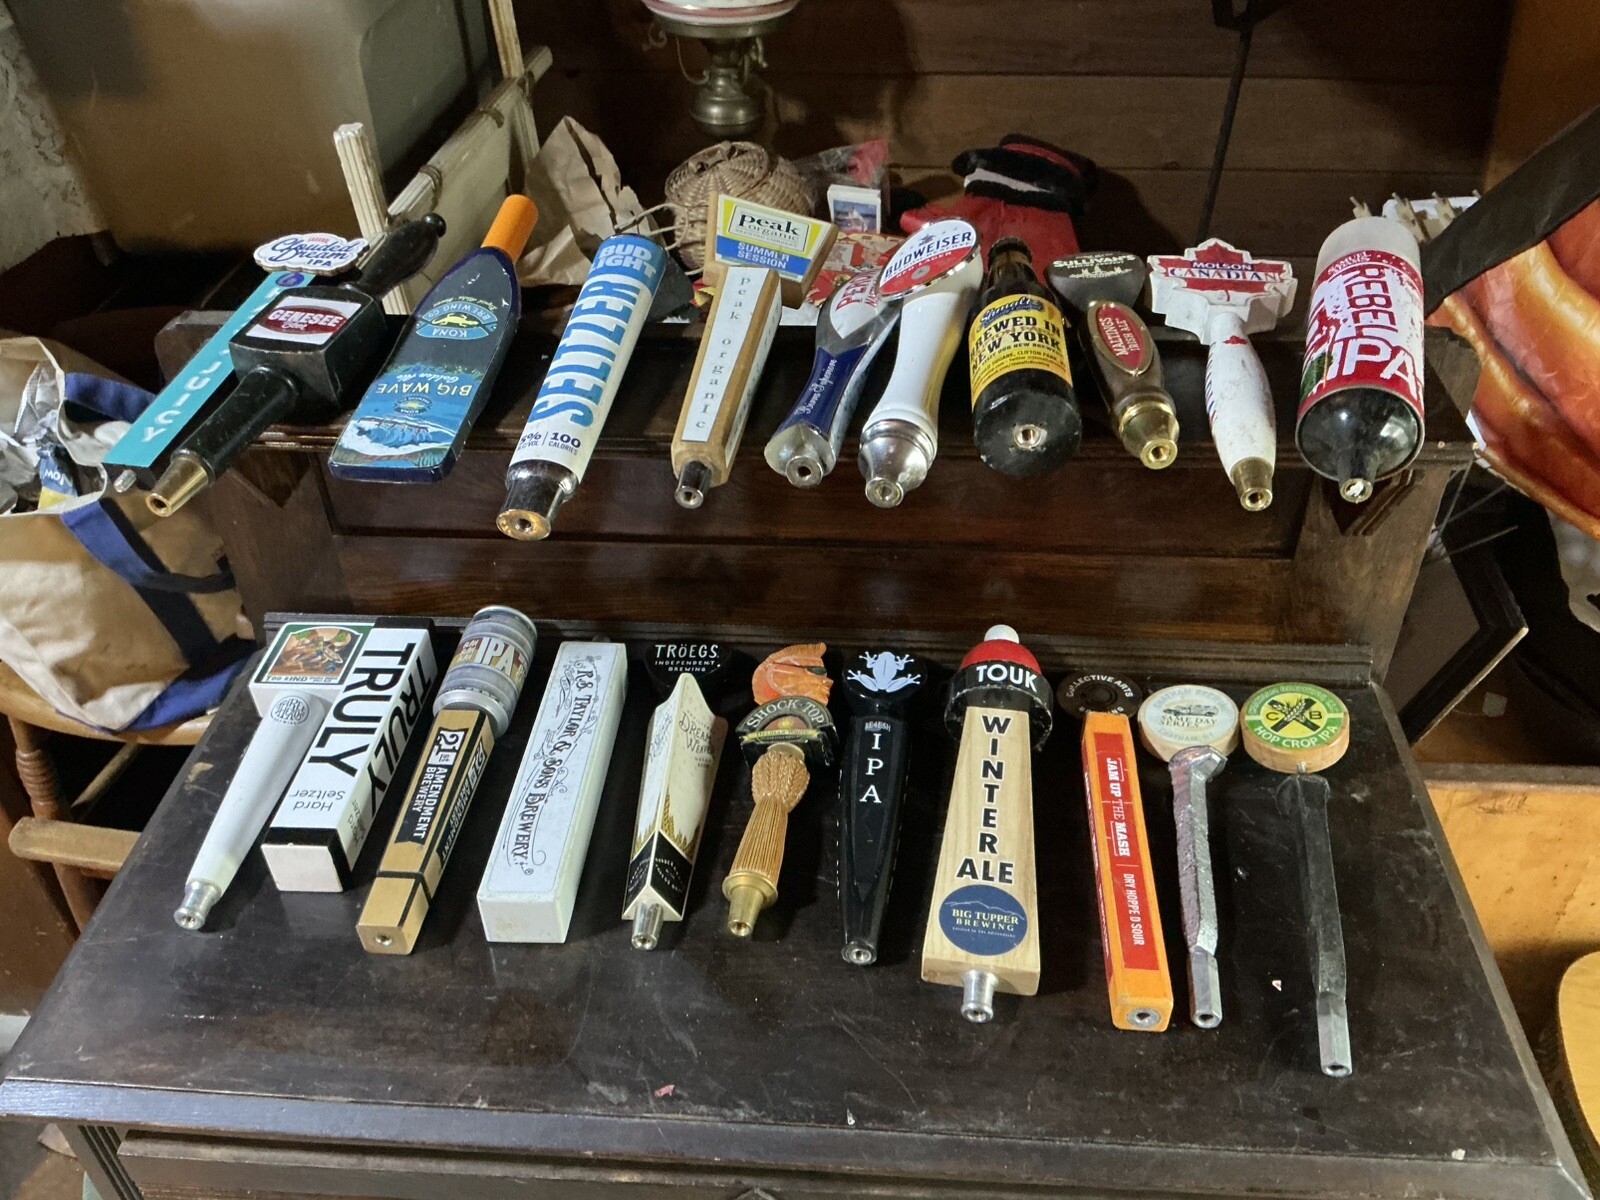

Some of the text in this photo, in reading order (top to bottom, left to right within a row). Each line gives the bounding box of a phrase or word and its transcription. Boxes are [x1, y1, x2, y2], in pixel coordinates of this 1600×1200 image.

[739, 214, 800, 236] peak
[748, 224, 799, 242] organic
[268, 248, 349, 262] Dream
[272, 238, 360, 252] Clouded
[599, 243, 652, 261] BUD
[738, 242, 790, 262] SUMMER
[885, 231, 972, 278] BUDWEISER
[307, 259, 332, 267] IPA
[590, 256, 657, 278] LIGHT
[737, 250, 787, 269] SESSION
[1053, 255, 1136, 268] SULLIVAN'S
[1193, 261, 1252, 271] MOLSON
[1170, 268, 1280, 282] CANADIAN
[443, 303, 491, 321] BREWING
[1343, 267, 1398, 337] REBEL
[268, 309, 344, 327] GENESEE
[432, 328, 468, 338] KONA
[1044, 320, 1061, 337] IN
[528, 279, 642, 428] SELTZER
[696, 277, 751, 429] peak organic
[972, 337, 1002, 374] NEW
[1010, 331, 1060, 351] YORK
[418, 373, 459, 383] Golden
[1327, 338, 1418, 401] IPA
[375, 381, 473, 396] BIG WAVE
[142, 360, 222, 442] JUICY
[549, 440, 578, 456] CALORIES
[551, 432, 581, 448] 100
[474, 636, 515, 677] IPA
[655, 643, 719, 659] TRÖEGS
[976, 664, 1038, 692] TOUK
[1066, 674, 1134, 698] COLLECTIVE ARTS
[308, 643, 417, 778] TRULY
[558, 695, 592, 740] TAYLOR
[747, 699, 825, 728] SHOCK TOP
[1265, 710, 1323, 721] C B
[1160, 720, 1200, 728] SERIES
[1195, 717, 1217, 725] DAY
[368, 656, 432, 818] TRULY
[1254, 726, 1338, 748] HOP CROP IPA
[549, 740, 572, 755] &
[533, 757, 563, 789] SONS
[859, 733, 884, 804] IPA
[290, 788, 346, 801] Seltzer
[412, 766, 437, 812] BREWERY
[978, 715, 1012, 854] WINTER
[293, 800, 333, 811] Hard
[413, 766, 448, 839] AMENDMENT
[1106, 757, 1131, 857] JAM UP THE MASH
[511, 792, 547, 861] BREWERY
[956, 857, 1014, 885] ALE
[952, 908, 1019, 925] BIG TUPPER
[1123, 873, 1135, 888] DRY
[1131, 924, 1146, 946] SOUR
[956, 918, 1014, 932] BREWING
